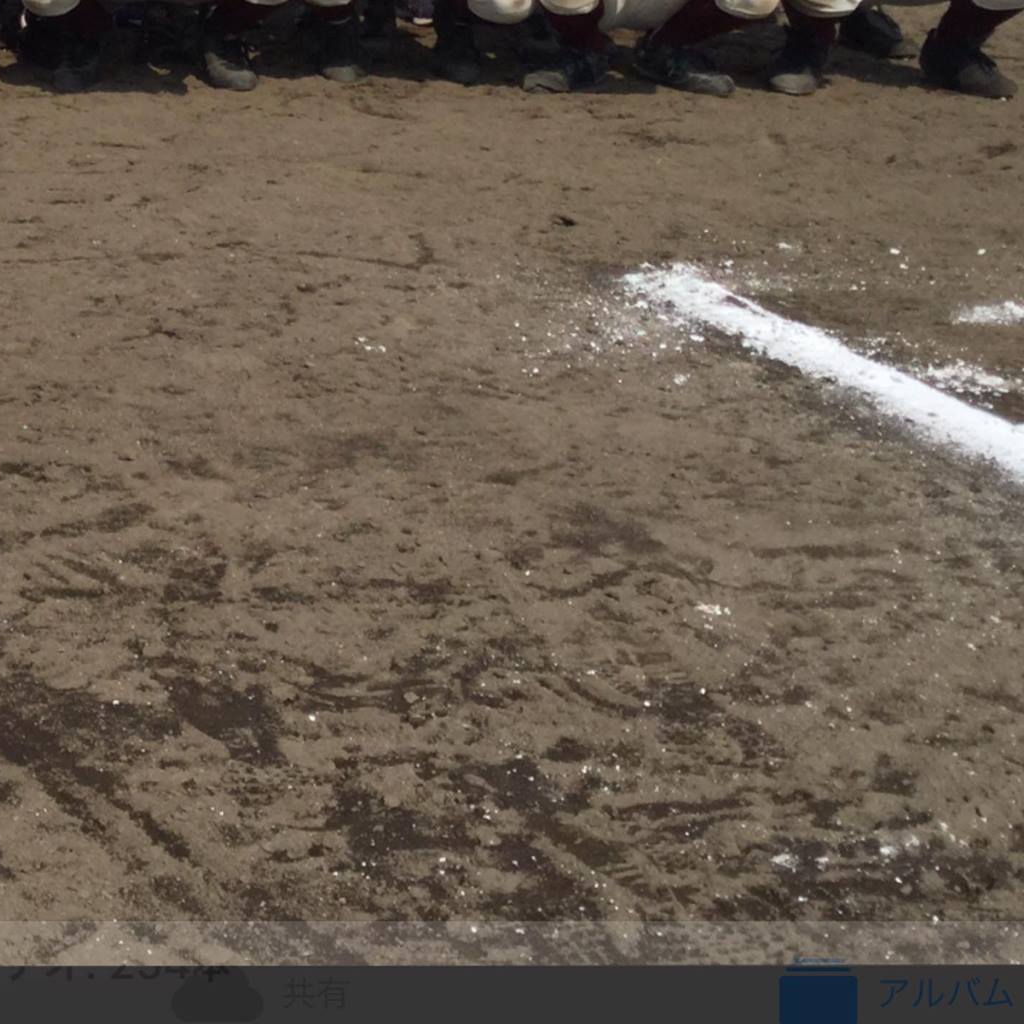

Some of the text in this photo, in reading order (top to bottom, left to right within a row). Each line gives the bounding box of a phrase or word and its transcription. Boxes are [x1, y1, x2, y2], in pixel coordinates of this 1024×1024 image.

[280, 977, 351, 1008] 共有
[880, 977, 1013, 1008] アルバム
